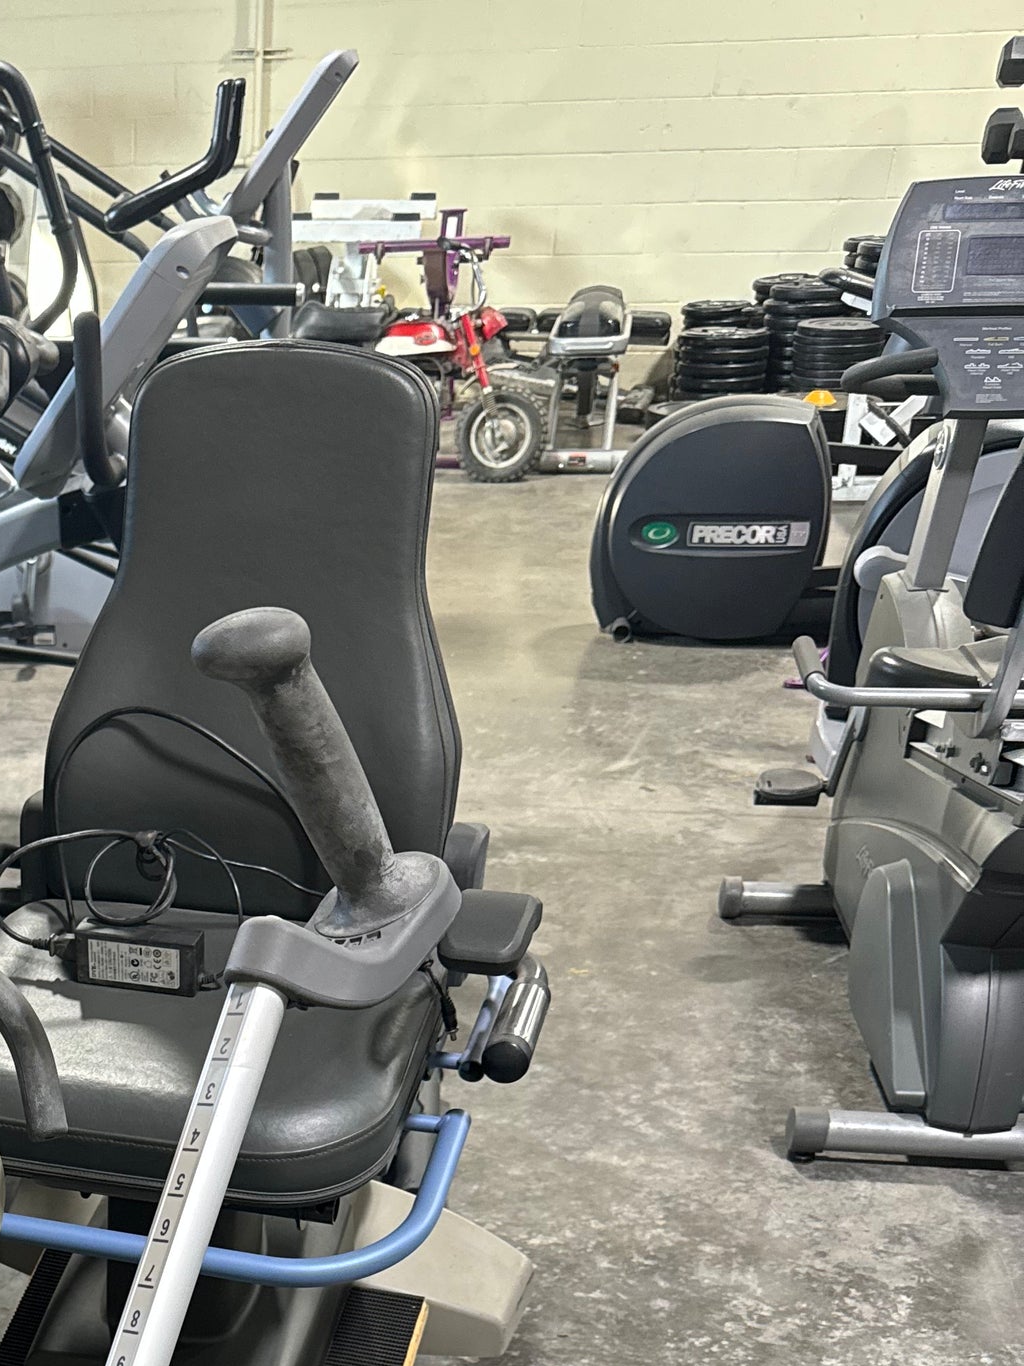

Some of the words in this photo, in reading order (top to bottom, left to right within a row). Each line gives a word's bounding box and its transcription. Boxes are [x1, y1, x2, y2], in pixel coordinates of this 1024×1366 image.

[692, 525, 775, 544] PRECOR
[235, 992, 244, 1009] 1
[219, 1037, 231, 1055] 2
[205, 1082, 216, 1100] 3
[190, 1128, 201, 1145] 4
[174, 1173, 186, 1191] 5
[144, 1264, 156, 1282] 7
[130, 1309, 141, 1327] 8
